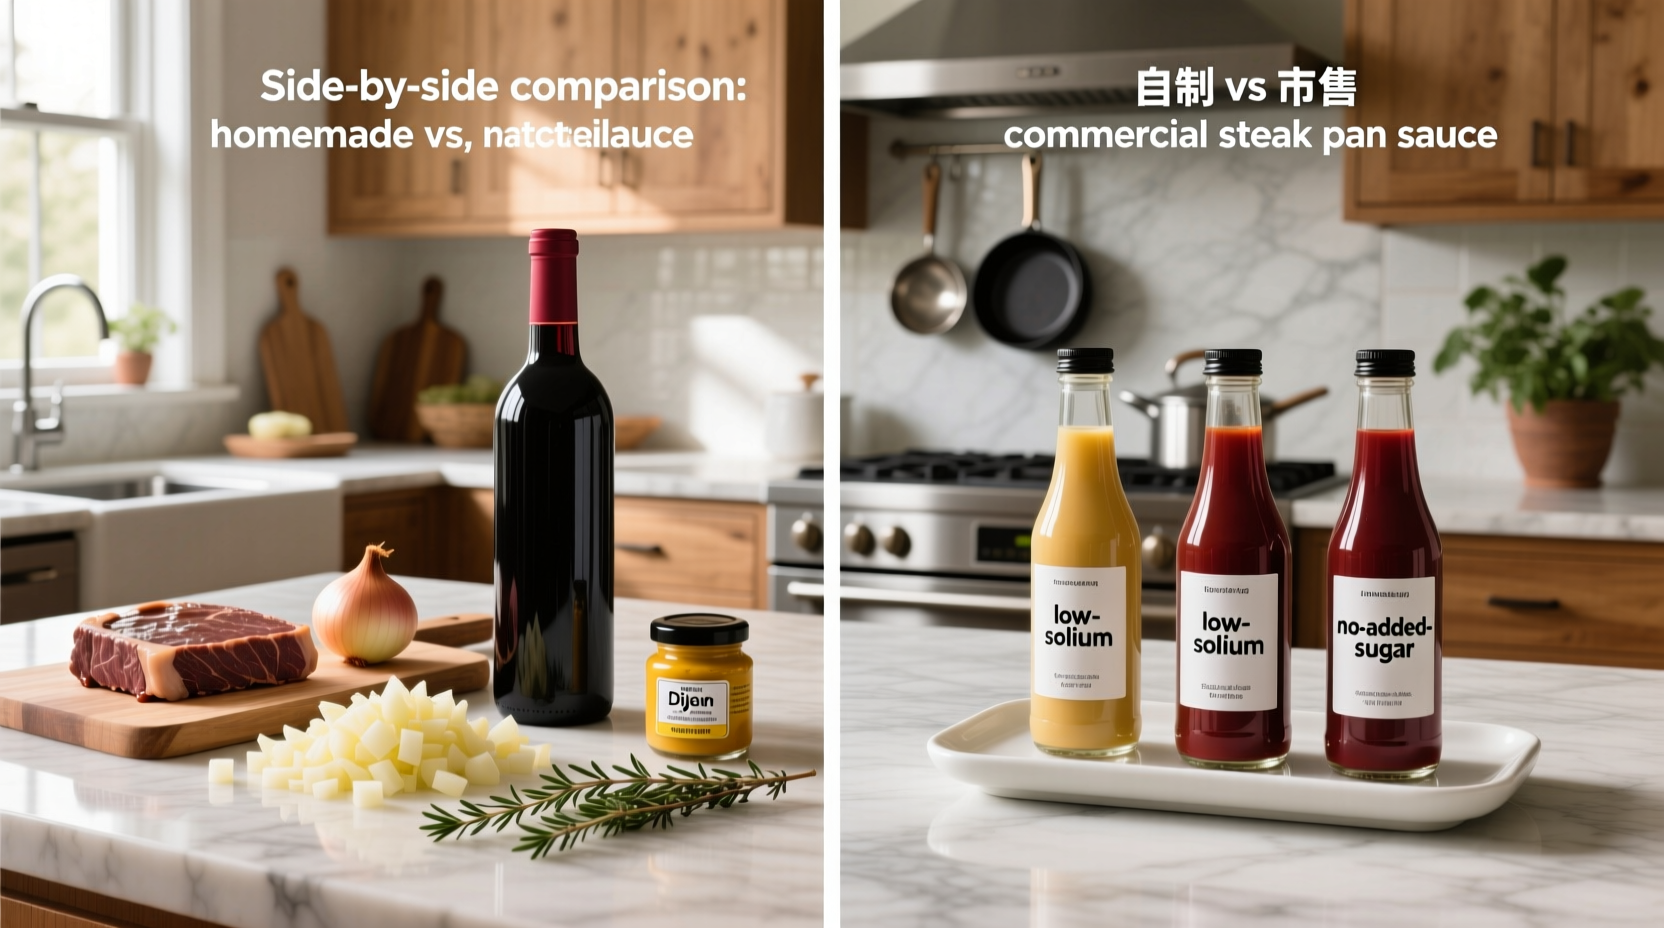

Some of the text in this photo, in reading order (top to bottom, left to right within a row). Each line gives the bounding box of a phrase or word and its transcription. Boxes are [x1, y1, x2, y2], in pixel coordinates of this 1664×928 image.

[1054, 604, 1101, 625] low-
[1202, 611, 1250, 632] low-
[1045, 626, 1113, 647] solium
[1337, 616, 1433, 637] no-added-
[1193, 635, 1264, 656] solium
[1354, 642, 1415, 664] sugar
